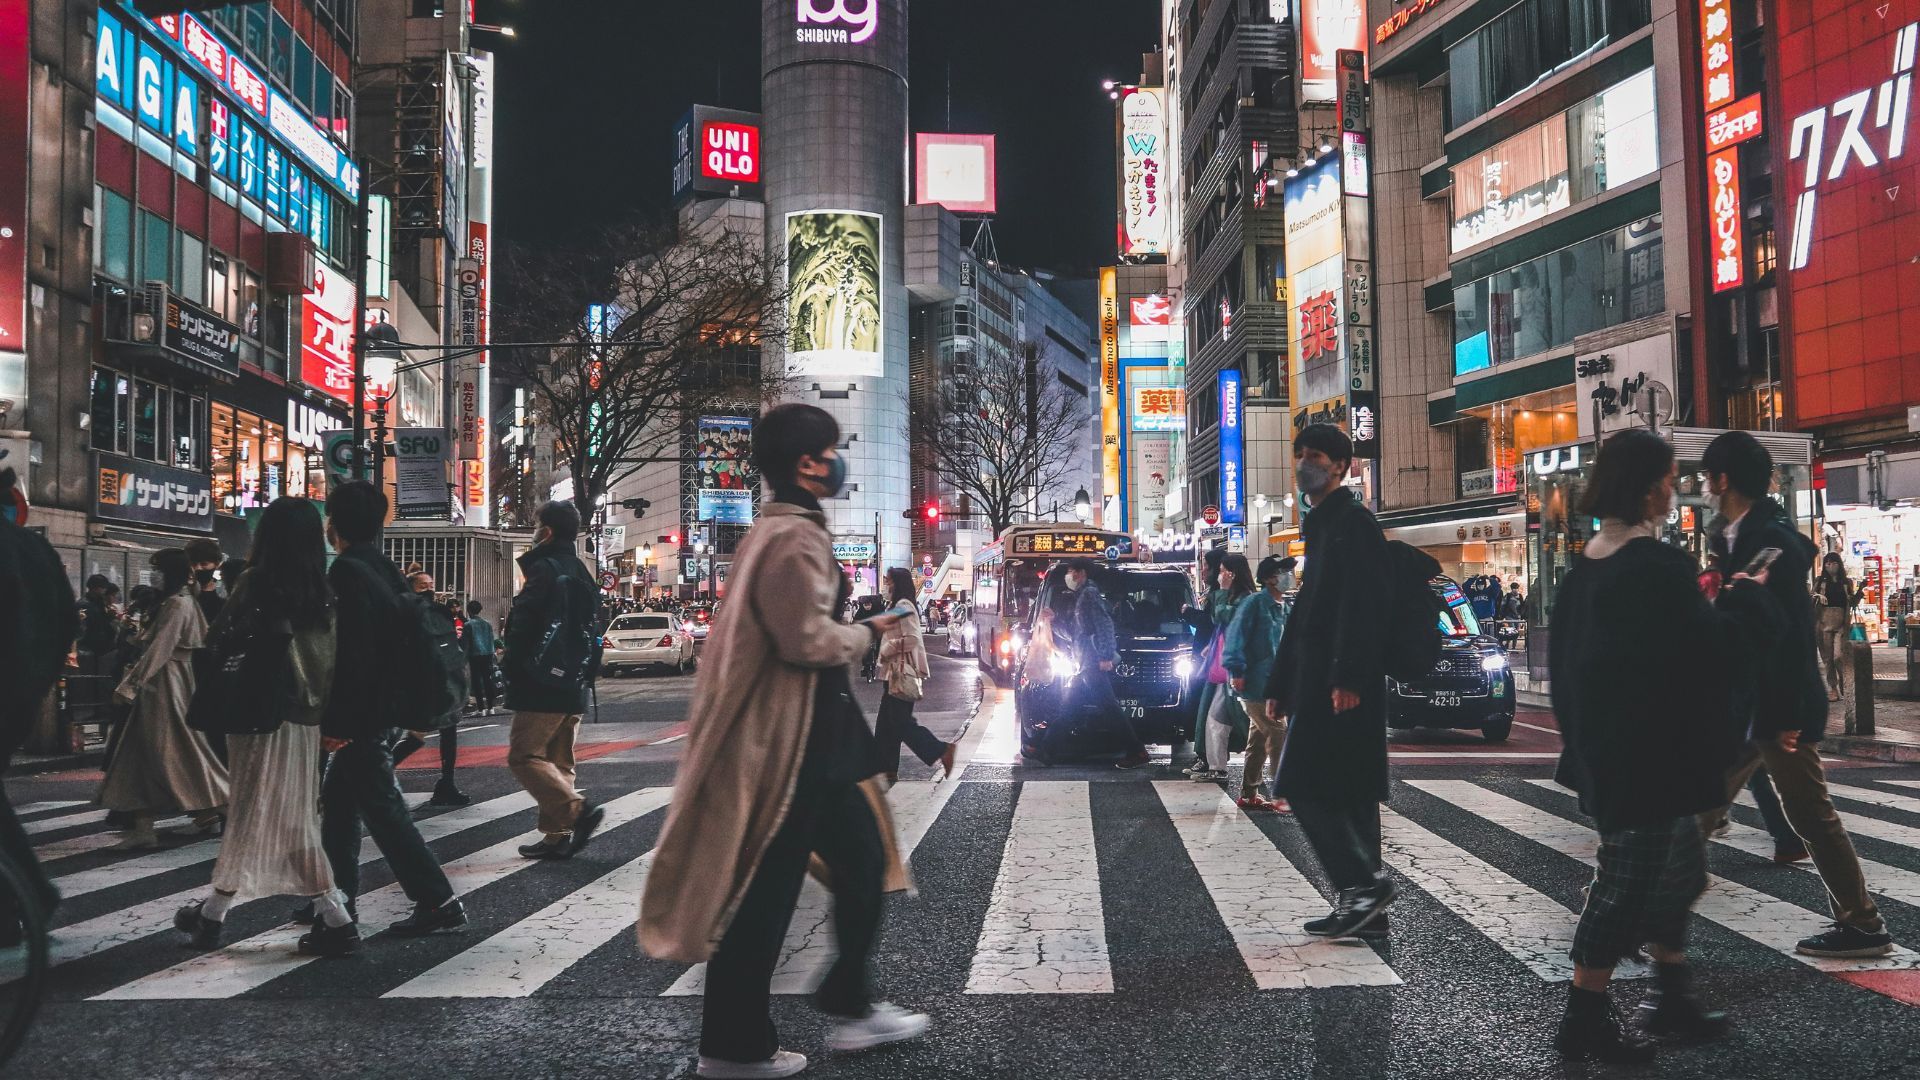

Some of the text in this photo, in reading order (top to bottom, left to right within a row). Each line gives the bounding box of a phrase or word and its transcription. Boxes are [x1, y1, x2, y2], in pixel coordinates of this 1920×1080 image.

[796, 28, 847, 43] SHIBUYA
[97, 25, 196, 156] AGA
[678, 122, 689, 159] THE
[709, 127, 749, 153] UNI
[1789, 22, 1919, 270] クスリ
[673, 151, 692, 196] PRIME
[708, 150, 753, 176] QLO
[341, 161, 360, 198] 4F
[1288, 207, 1327, 235] Matsumoto
[1714, 158, 1738, 285] もんじゃ焼
[472, 237, 485, 266] 免税
[1350, 278, 1359, 311] パーラー
[1360, 275, 1368, 306] フルーツ
[1300, 290, 1339, 361] 薬
[181, 337, 196, 351] DRUG
[1105, 336, 1114, 396] Matsumoto
[1352, 344, 1360, 376] フルーツ
[325, 365, 337, 389] 3F
[463, 382, 475, 442] 処方せん受付
[1226, 380, 1237, 428] MIZUHO
[1356, 406, 1374, 441] HUB
[400, 436, 440, 454] SFW
[1105, 434, 1117, 445] 薬
[102, 471, 117, 501] 薬
[136, 477, 211, 516] サンドラッグ
[1226, 461, 1238, 511] みずほ銀行
[605, 528, 623, 536] SFW
[1055, 540, 1105, 551] 渋谷駅
[687, 560, 696, 573] S
[1434, 696, 1461, 707] 62-03
